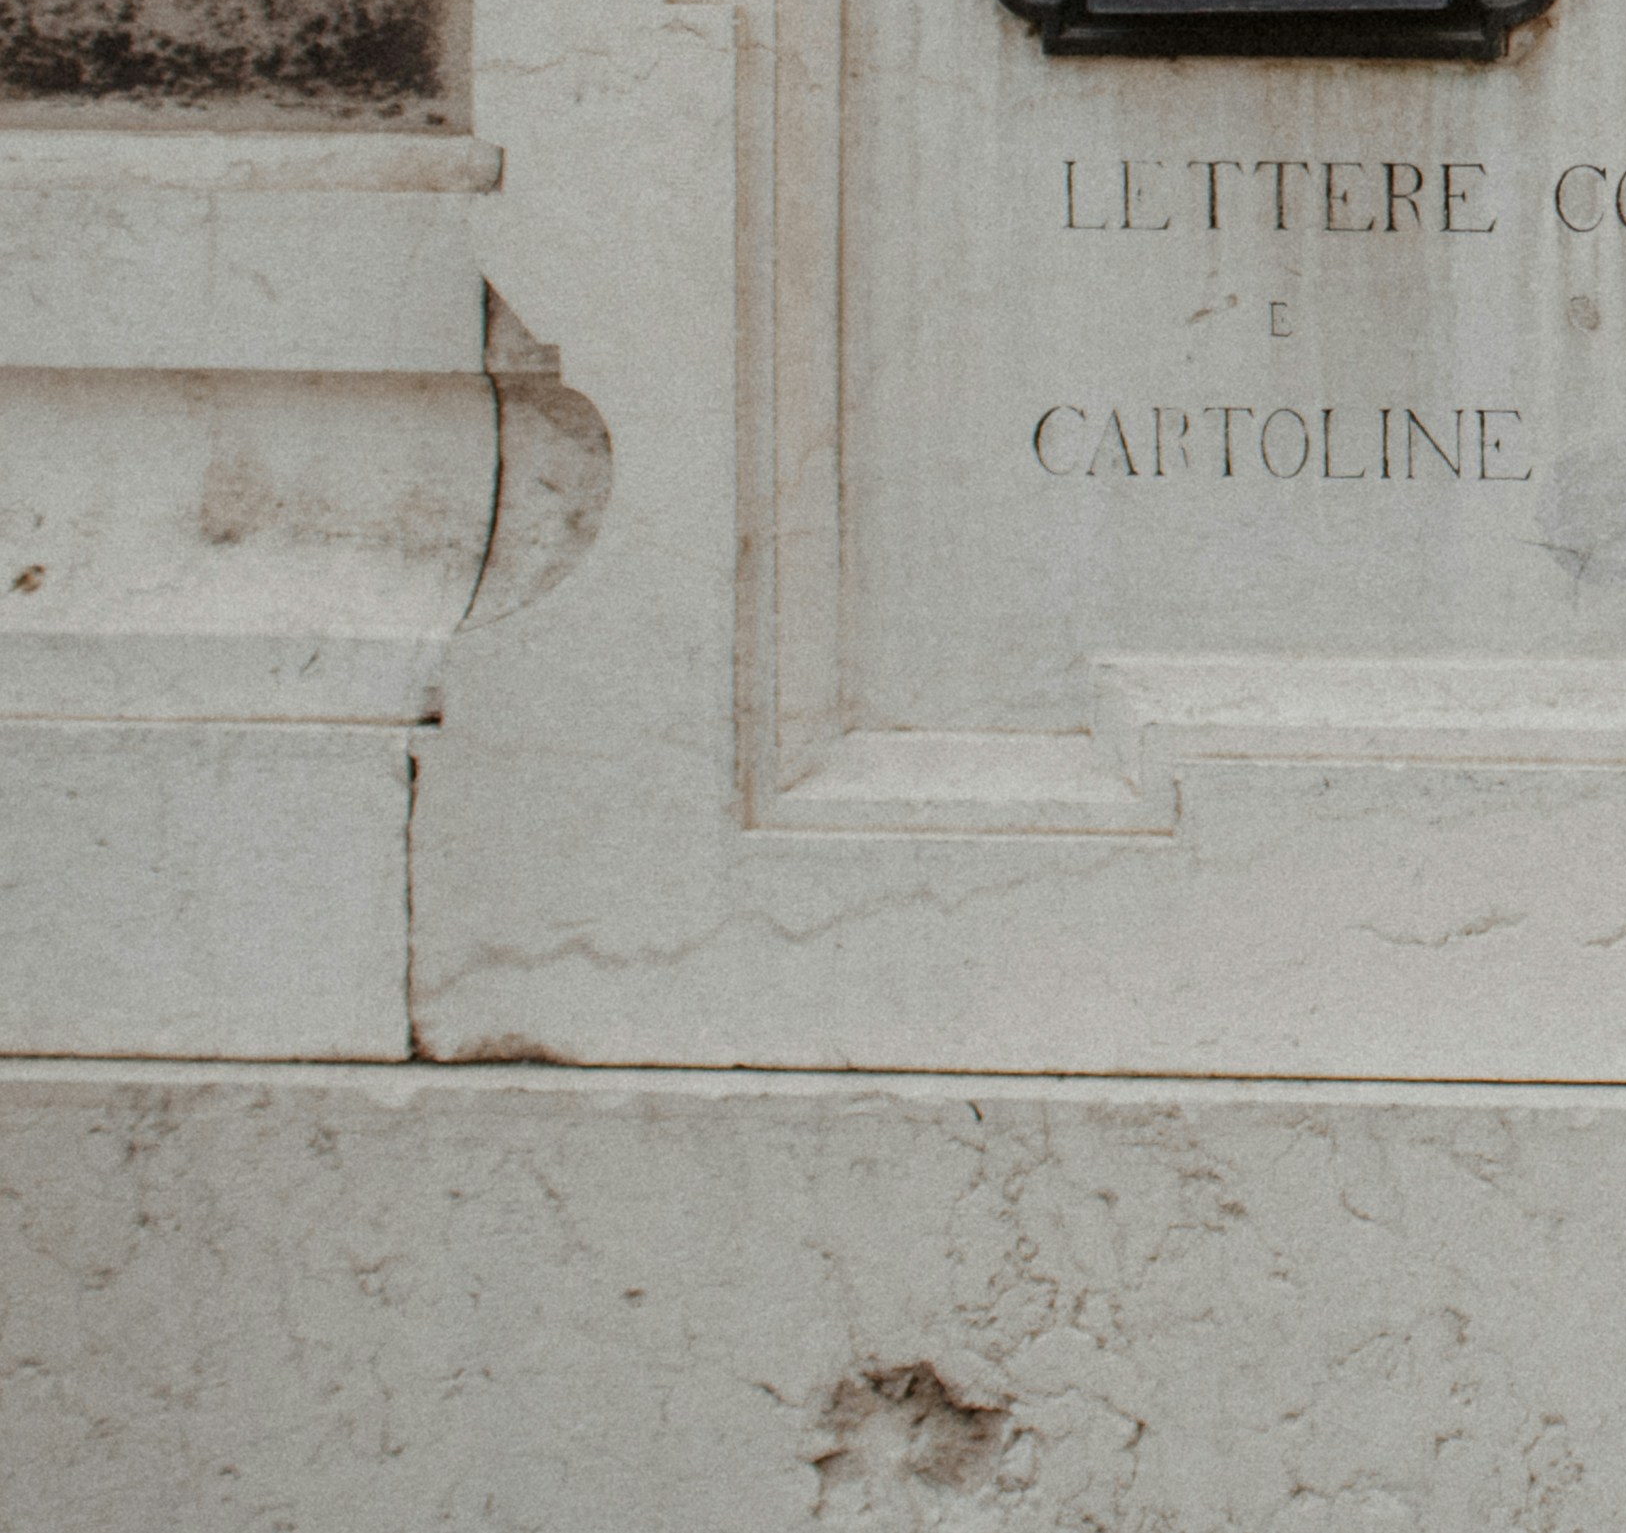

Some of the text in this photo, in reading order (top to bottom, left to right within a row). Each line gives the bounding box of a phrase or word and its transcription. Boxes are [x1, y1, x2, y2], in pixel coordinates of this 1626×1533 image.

[1063, 159, 1498, 234] LETTERE
[1269, 301, 1292, 337] E
[1033, 405, 1533, 482] CARTOLINE
